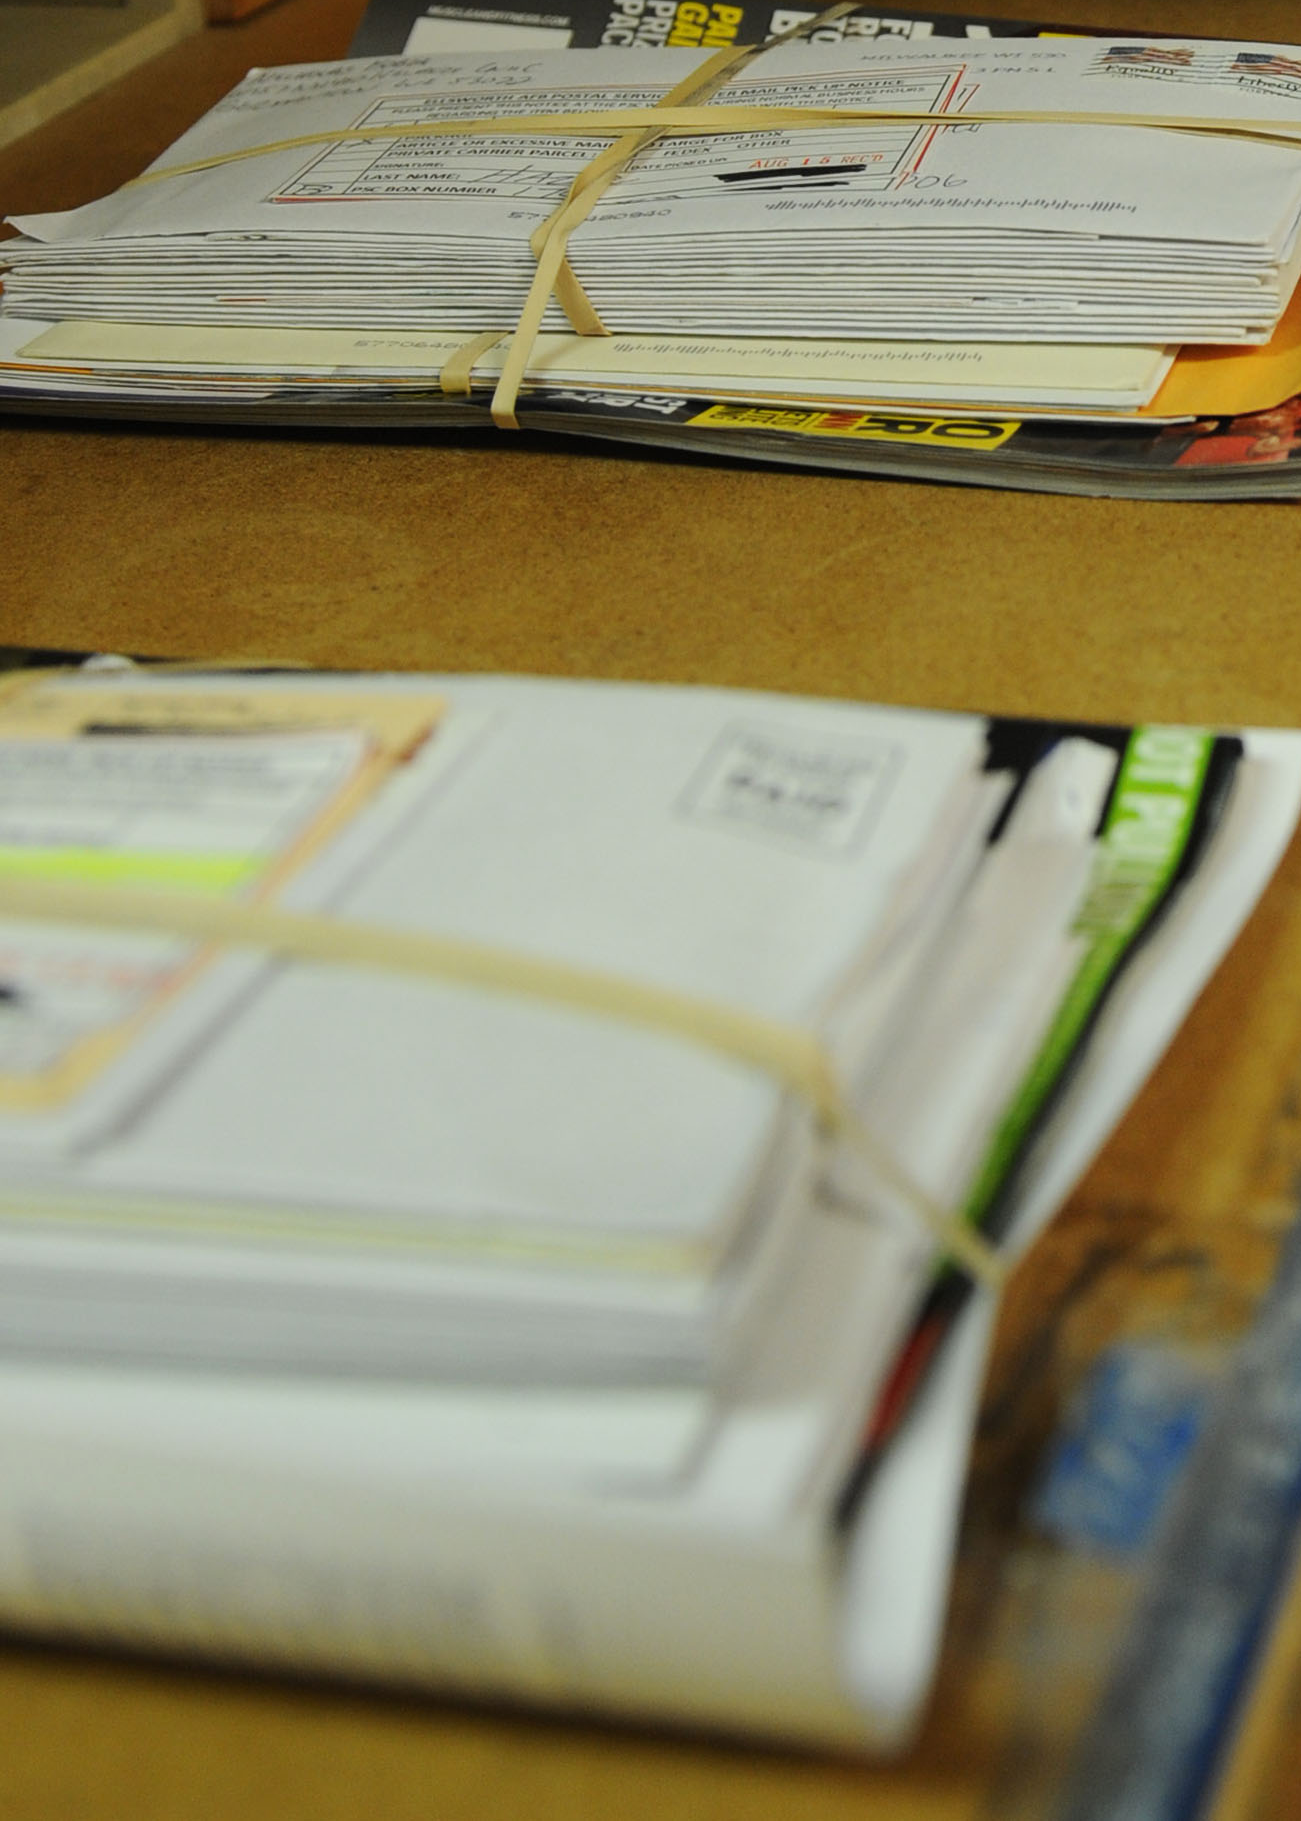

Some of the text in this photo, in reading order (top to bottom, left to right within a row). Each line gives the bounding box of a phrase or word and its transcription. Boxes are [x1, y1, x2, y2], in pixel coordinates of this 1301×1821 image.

[1105, 64, 1178, 76] Equality
[424, 95, 514, 105] ELLSWORTH
[519, 93, 548, 101] AFB
[740, 87, 778, 96] MAIL
[847, 79, 905, 88] NOTICE
[391, 106, 435, 114] PLEASE
[438, 104, 491, 112] PRESENT
[758, 93, 812, 102] NORMAL
[816, 90, 876, 98] BUSINESS
[881, 87, 926, 95] HOURS
[826, 96, 873, 104] NOTICE
[656, 130, 784, 147] LARGE FOR BOX
[387, 148, 451, 157] PRIVATE
[456, 148, 524, 156] CARRIER
[663, 139, 792, 156] FEDEX OTHER
[663, 159, 708, 167] PICKED
[749, 157, 789, 169] AUG
[840, 153, 884, 164] REC'D
[363, 173, 402, 181] LAST
[350, 186, 376, 194] PSC
[424, 186, 497, 194] NUMBER
